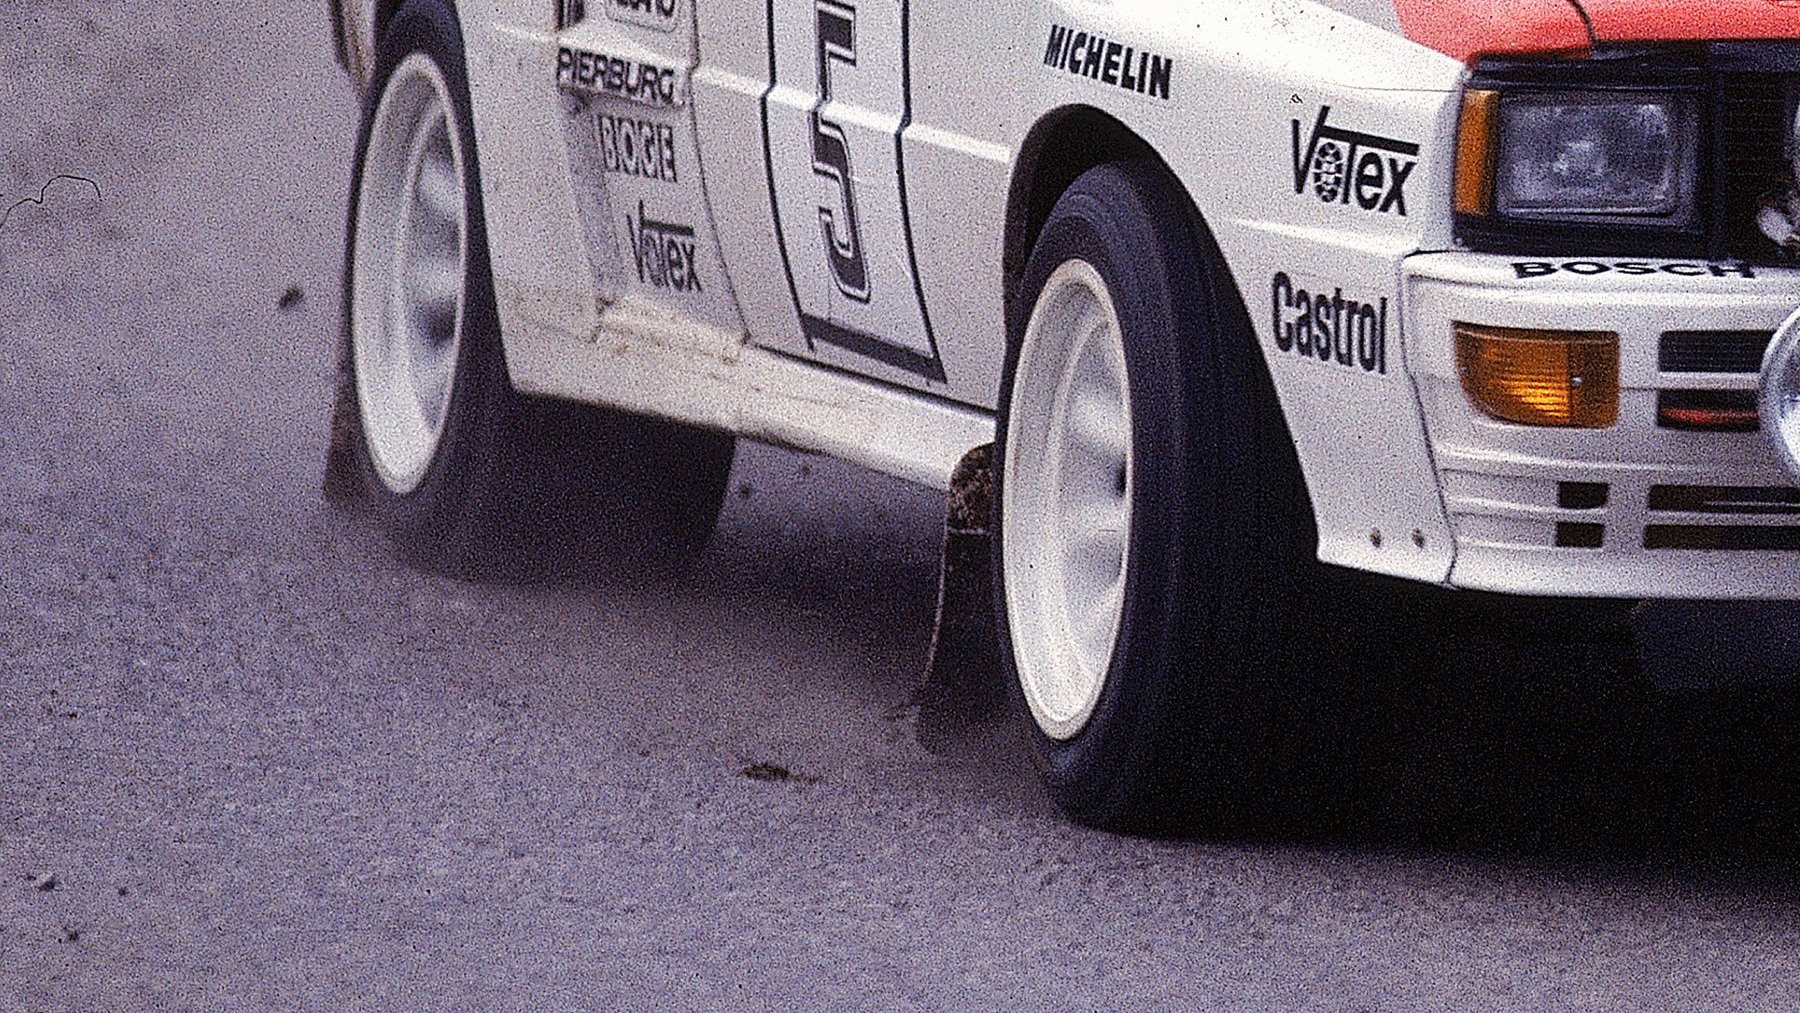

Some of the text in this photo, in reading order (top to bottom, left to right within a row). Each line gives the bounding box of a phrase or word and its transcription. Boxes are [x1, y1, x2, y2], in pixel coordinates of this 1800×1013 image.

[557, 47, 674, 105] PIERBURG
[1043, 24, 1173, 100] MICHELIN
[1511, 260, 1756, 280] BOSCH
[1272, 271, 1388, 375] Castrol
